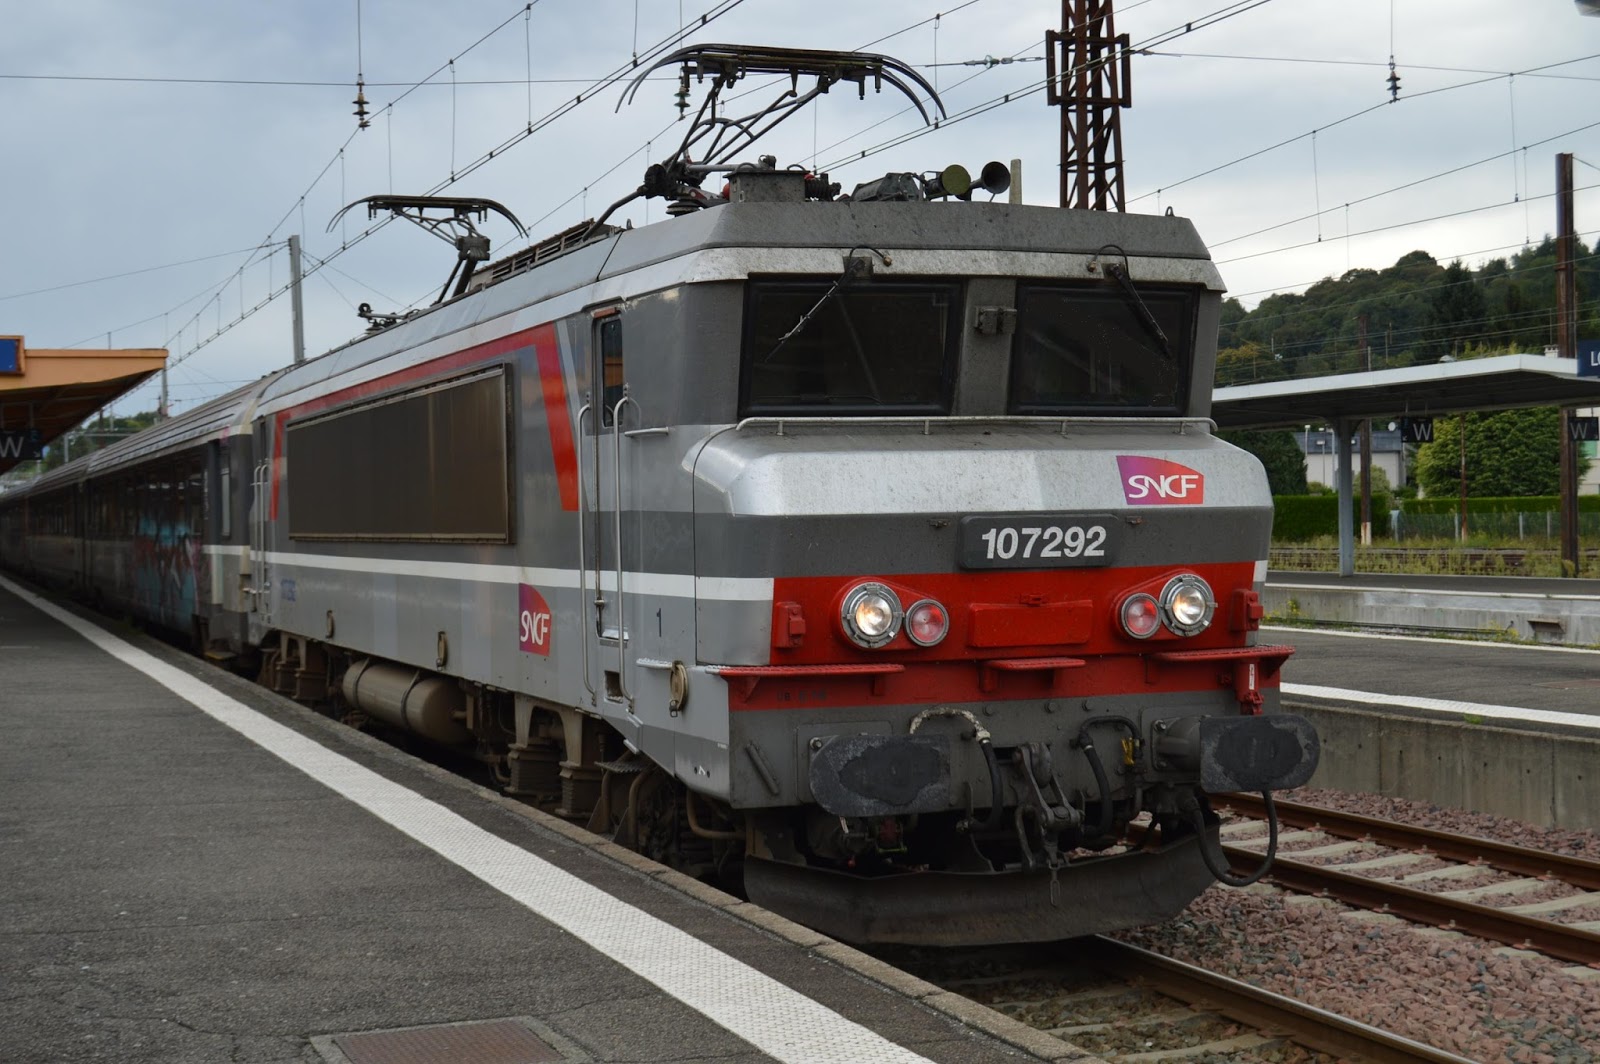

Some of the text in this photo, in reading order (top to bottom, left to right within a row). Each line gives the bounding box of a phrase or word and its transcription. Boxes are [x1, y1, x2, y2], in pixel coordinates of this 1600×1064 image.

[1413, 423, 1432, 441] W
[1570, 422, 1588, 440] W
[0, 436, 24, 458] W
[1128, 474, 1199, 499] SNCF
[982, 526, 1107, 560] 107292
[520, 610, 550, 646] SNCF
